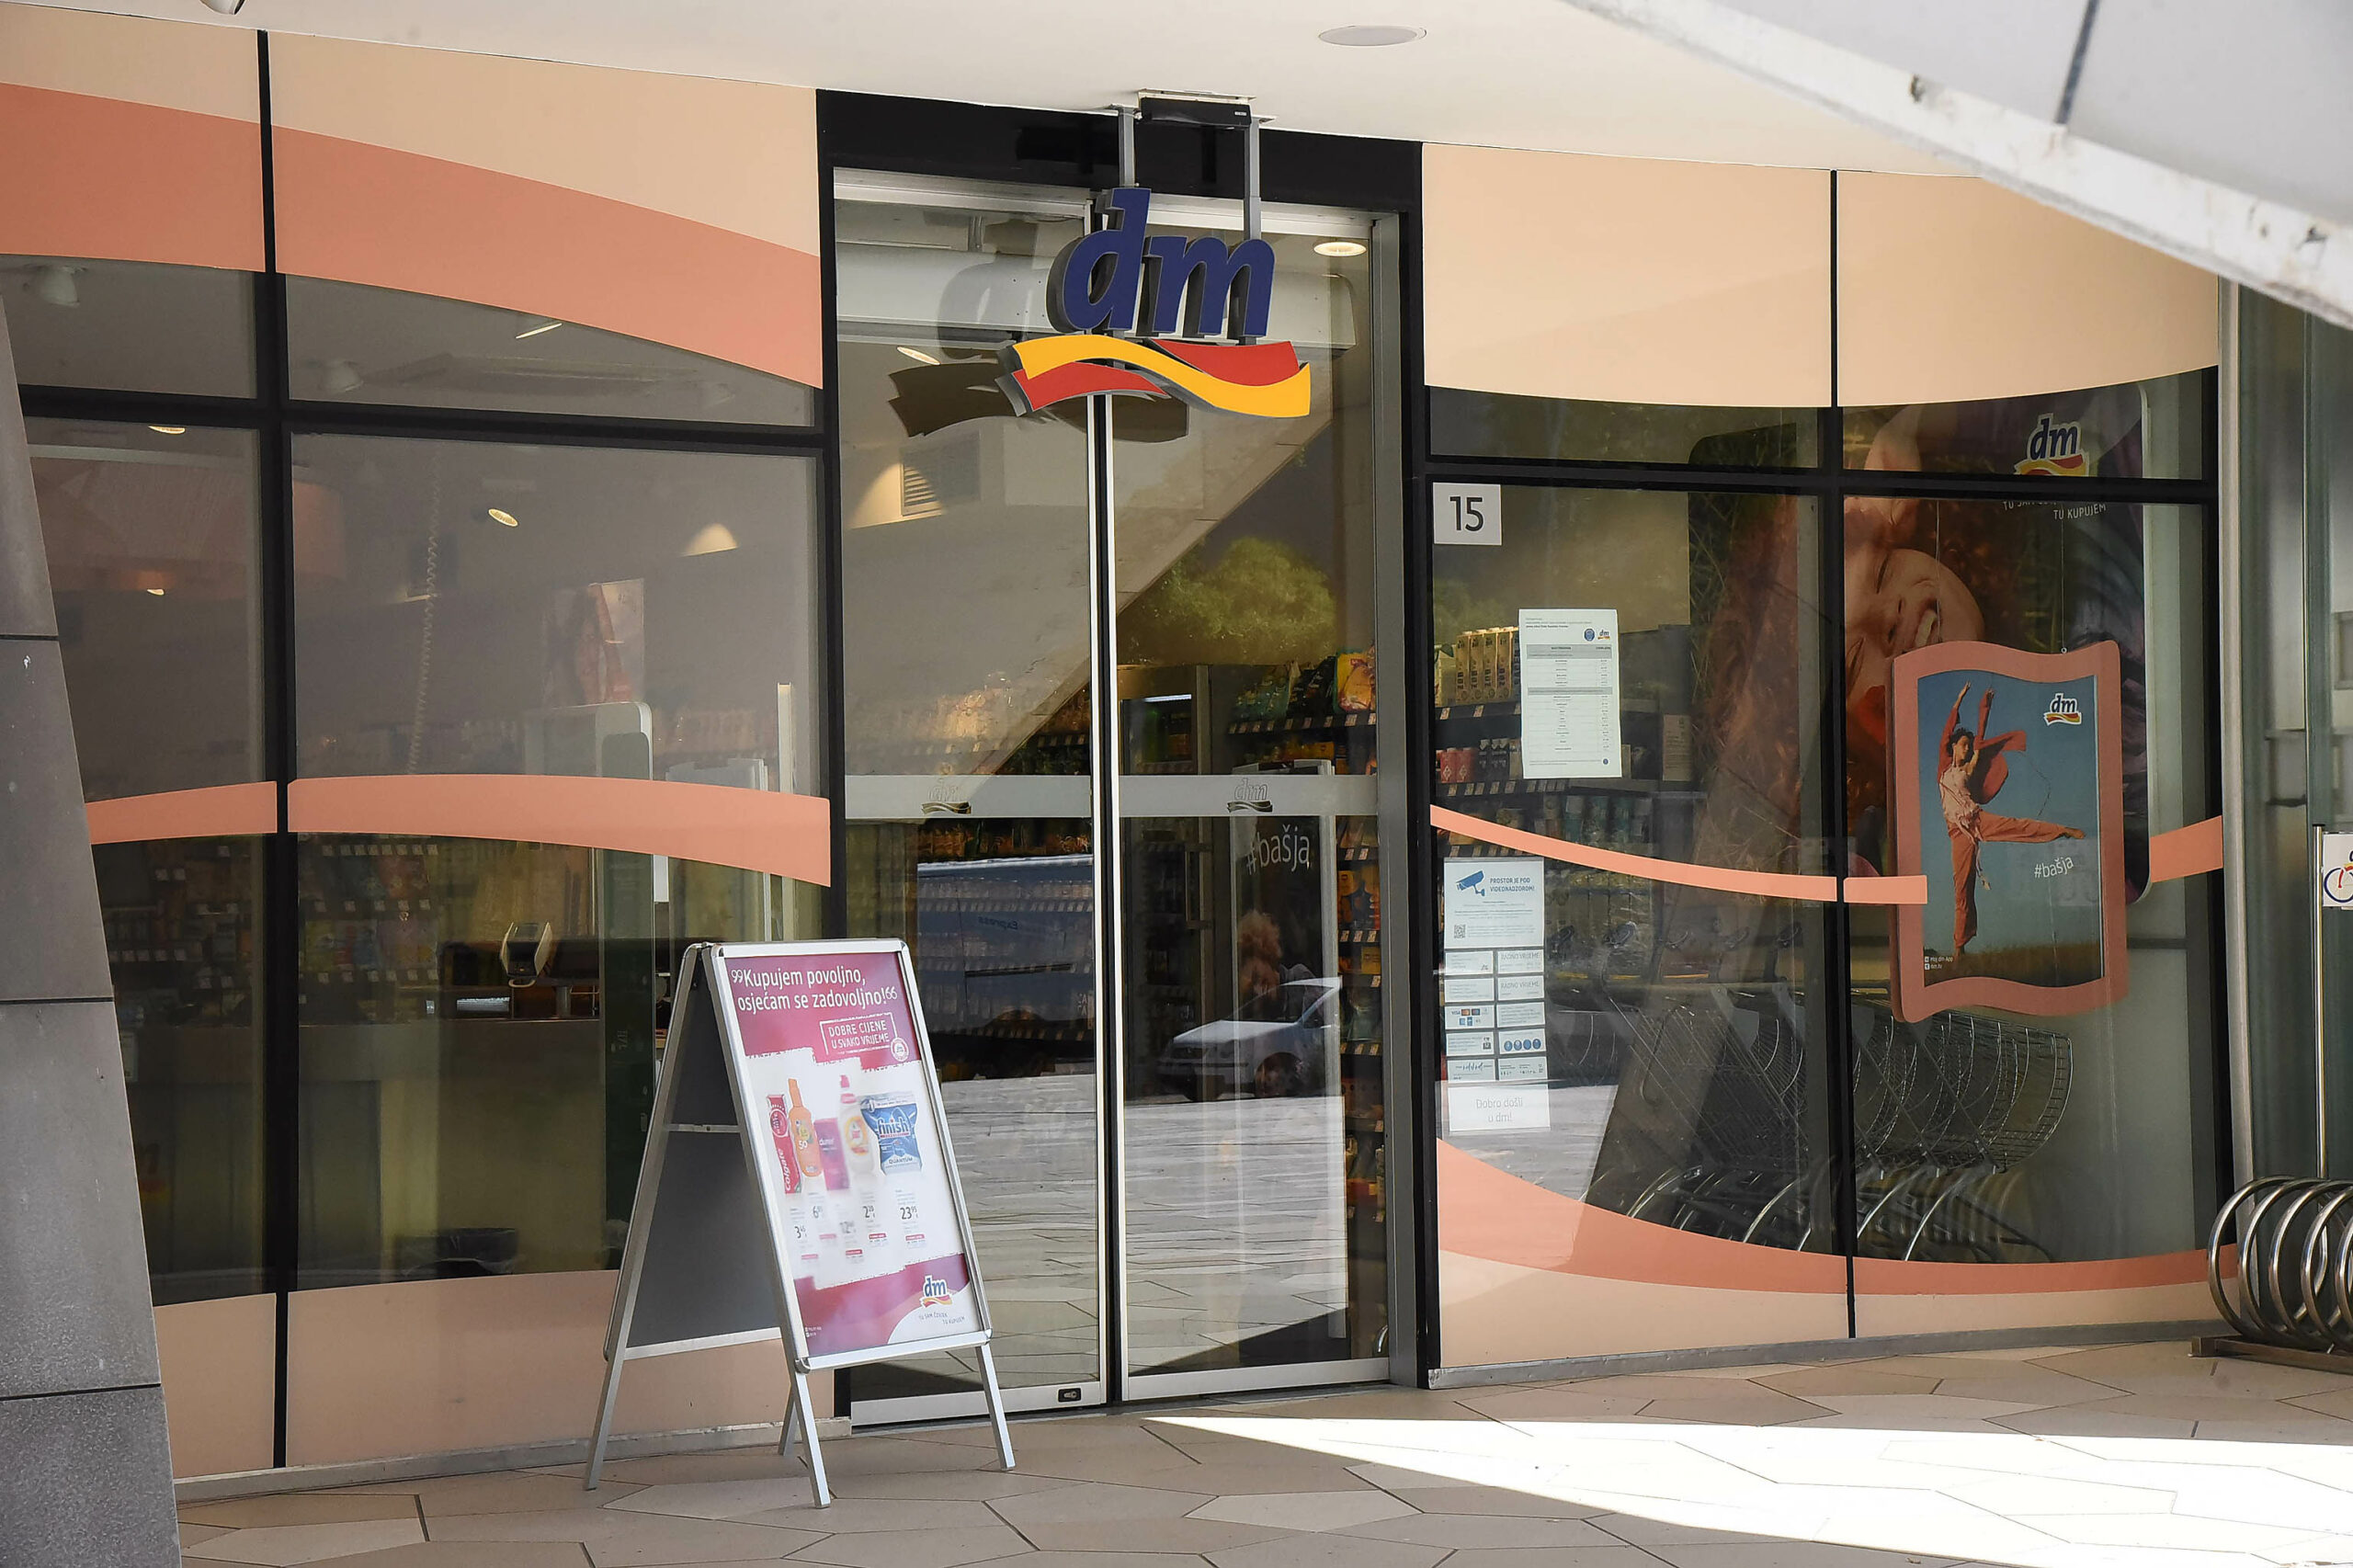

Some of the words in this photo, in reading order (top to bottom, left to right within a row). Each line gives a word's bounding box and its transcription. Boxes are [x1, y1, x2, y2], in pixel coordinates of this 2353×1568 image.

[1048, 187, 1276, 337] dm
[2029, 417, 2078, 460] dm
[1449, 495, 1484, 532] 15
[2053, 509, 2064, 520] TU
[2066, 503, 2107, 519] KUPUJEM
[2051, 694, 2077, 713] dm
[1233, 778, 1267, 801] dm
[1246, 824, 1311, 876] #bašja
[2034, 856, 2075, 879] #bašja
[807, 965, 866, 988] povoljno,
[738, 992, 790, 1014] osjećam
[795, 994, 809, 1008] se
[828, 1024, 858, 1037] DOBRE
[858, 1020, 887, 1033] CIJENE
[831, 1039, 837, 1049] U
[837, 1037, 860, 1048] SVAKO
[860, 1033, 890, 1045] VRIJEME
[1476, 1099, 1501, 1108] Dobro
[877, 1118, 910, 1134] finish
[778, 1148, 791, 1191] Colgate
[925, 1278, 947, 1297] dm
